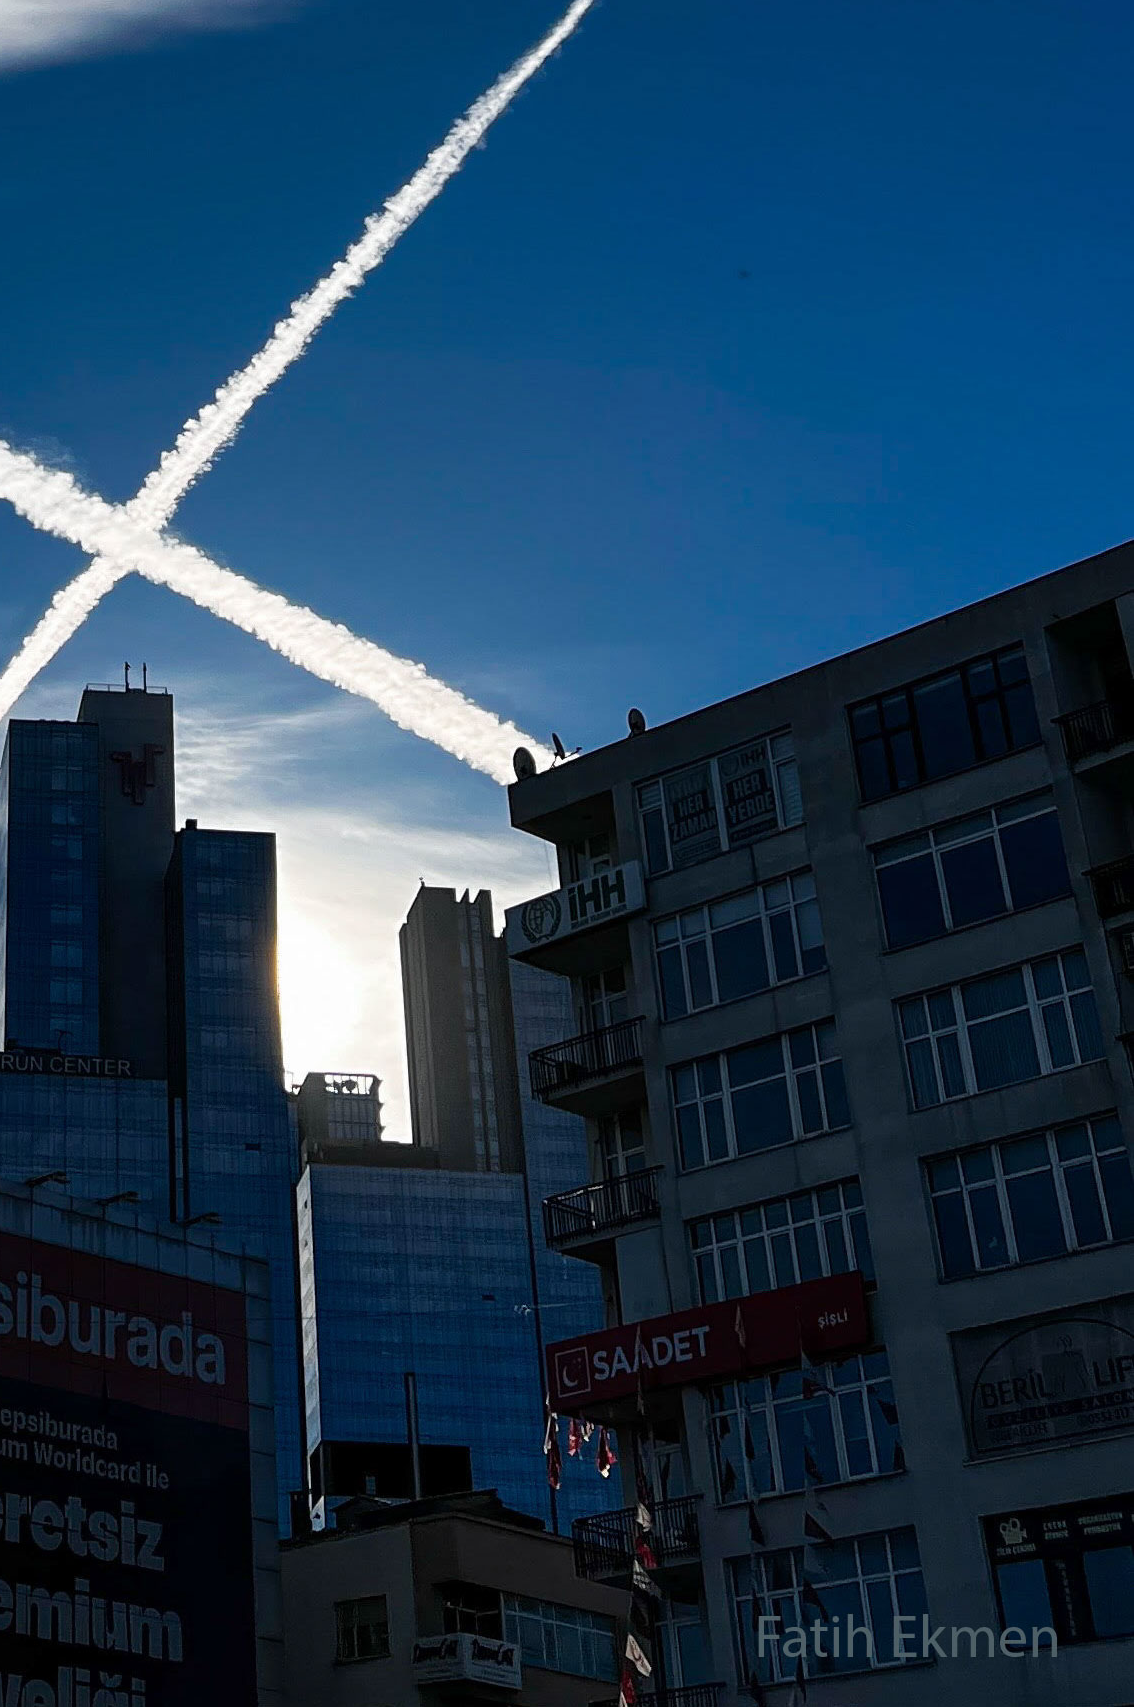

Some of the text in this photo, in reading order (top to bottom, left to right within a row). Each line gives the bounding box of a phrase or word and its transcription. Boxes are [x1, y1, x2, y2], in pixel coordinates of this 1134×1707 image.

[732, 771, 762, 800] HER
[49, 1056, 132, 1076] CENTER
[592, 1325, 710, 1381] SAADET
[980, 1367, 1050, 1409] BERİL
[33, 1440, 141, 1486] Worldcard
[145, 1463, 170, 1490] ile
